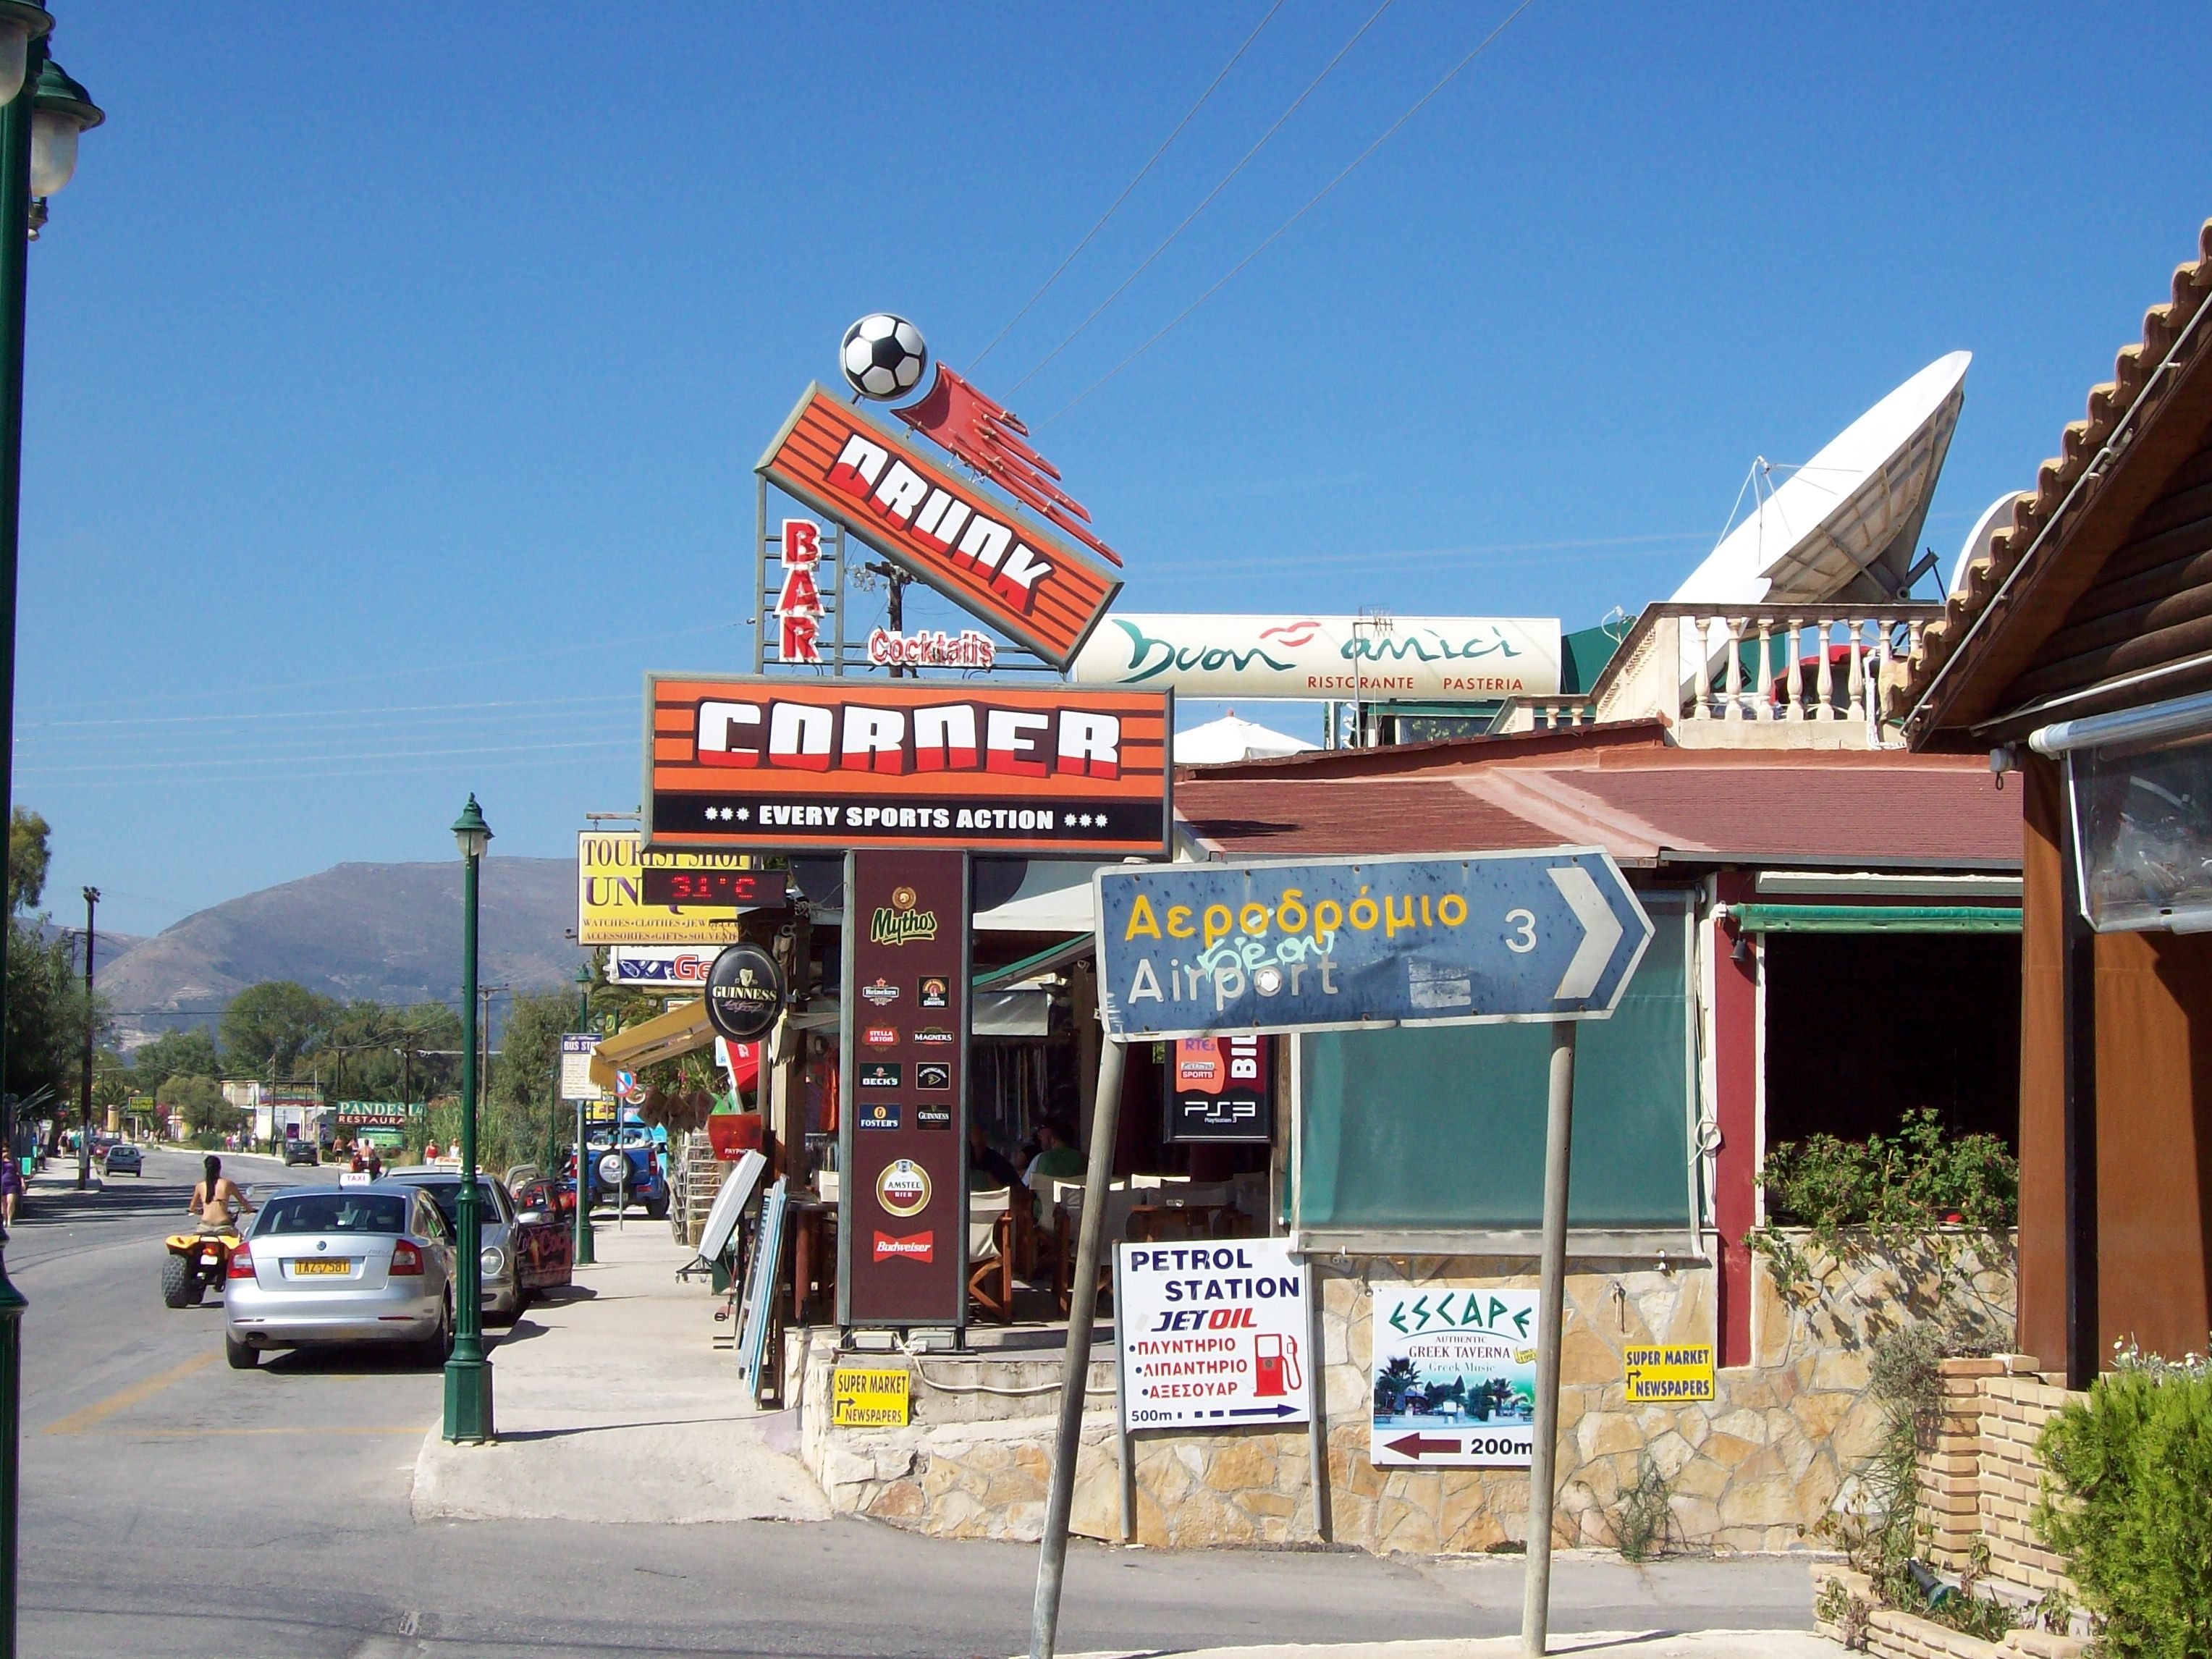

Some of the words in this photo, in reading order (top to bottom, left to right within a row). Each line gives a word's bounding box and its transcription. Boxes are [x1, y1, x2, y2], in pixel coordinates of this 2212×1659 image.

[826, 434, 1052, 616] DRUNK
[776, 520, 822, 662] BAR
[870, 629, 995, 667] Cocktails
[1341, 627, 1522, 662] amici
[1308, 675, 1414, 690] RISTORANTE
[1443, 677, 1523, 691] PASTERIA
[697, 701, 1120, 780] CORNER
[759, 805, 839, 827] EVERY
[845, 806, 949, 829] SPORTS
[956, 809, 1054, 830] ACTION
[583, 919, 630, 928] WATCHES
[635, 919, 680, 928] CLOTHES
[1125, 886, 1469, 948] Αεροδρόμιο
[871, 907, 937, 946] Mythos
[1505, 908, 1537, 953] 3
[586, 932, 651, 940] ACCESSORIES
[655, 932, 683, 940] GIFTS
[1127, 954, 1338, 1011] Airport
[712, 985, 777, 1002] GUINNESS
[564, 1041, 579, 1051] BUS
[918, 1111, 949, 1120] GUINNESS
[1185, 1101, 1255, 1117] PS3
[877, 1241, 931, 1252] Budweiser
[1131, 1248, 1253, 1272] PETROL
[1165, 1277, 1299, 1301] STATION
[1151, 1307, 1258, 1332] JETOIL
[1388, 1292, 1532, 1338] ESCAPE
[1138, 1338, 1236, 1355] ΠΛΥΝΤΗΡΙΟ
[1409, 1346, 1449, 1358] GREEK
[1454, 1346, 1511, 1358] TAVERNA
[1626, 1351, 1660, 1366] SUPER
[1665, 1349, 1709, 1365] MARKET
[1144, 1359, 1248, 1377] ΛΙΠΑΝΤΗΡΙΟ
[1429, 1362, 1461, 1372] Greek
[1464, 1362, 1495, 1372] Music
[838, 1375, 866, 1393] SUPER
[869, 1375, 906, 1394] MARKET
[1149, 1381, 1238, 1398] ΑΞΕΣΟΥΑΡ
[1636, 1380, 1710, 1397] NEWSPAPERS
[845, 1409, 902, 1423] NEWSPAPERS
[1131, 1410, 1172, 1422] 500m
[1471, 1438, 1532, 1455] 200m
